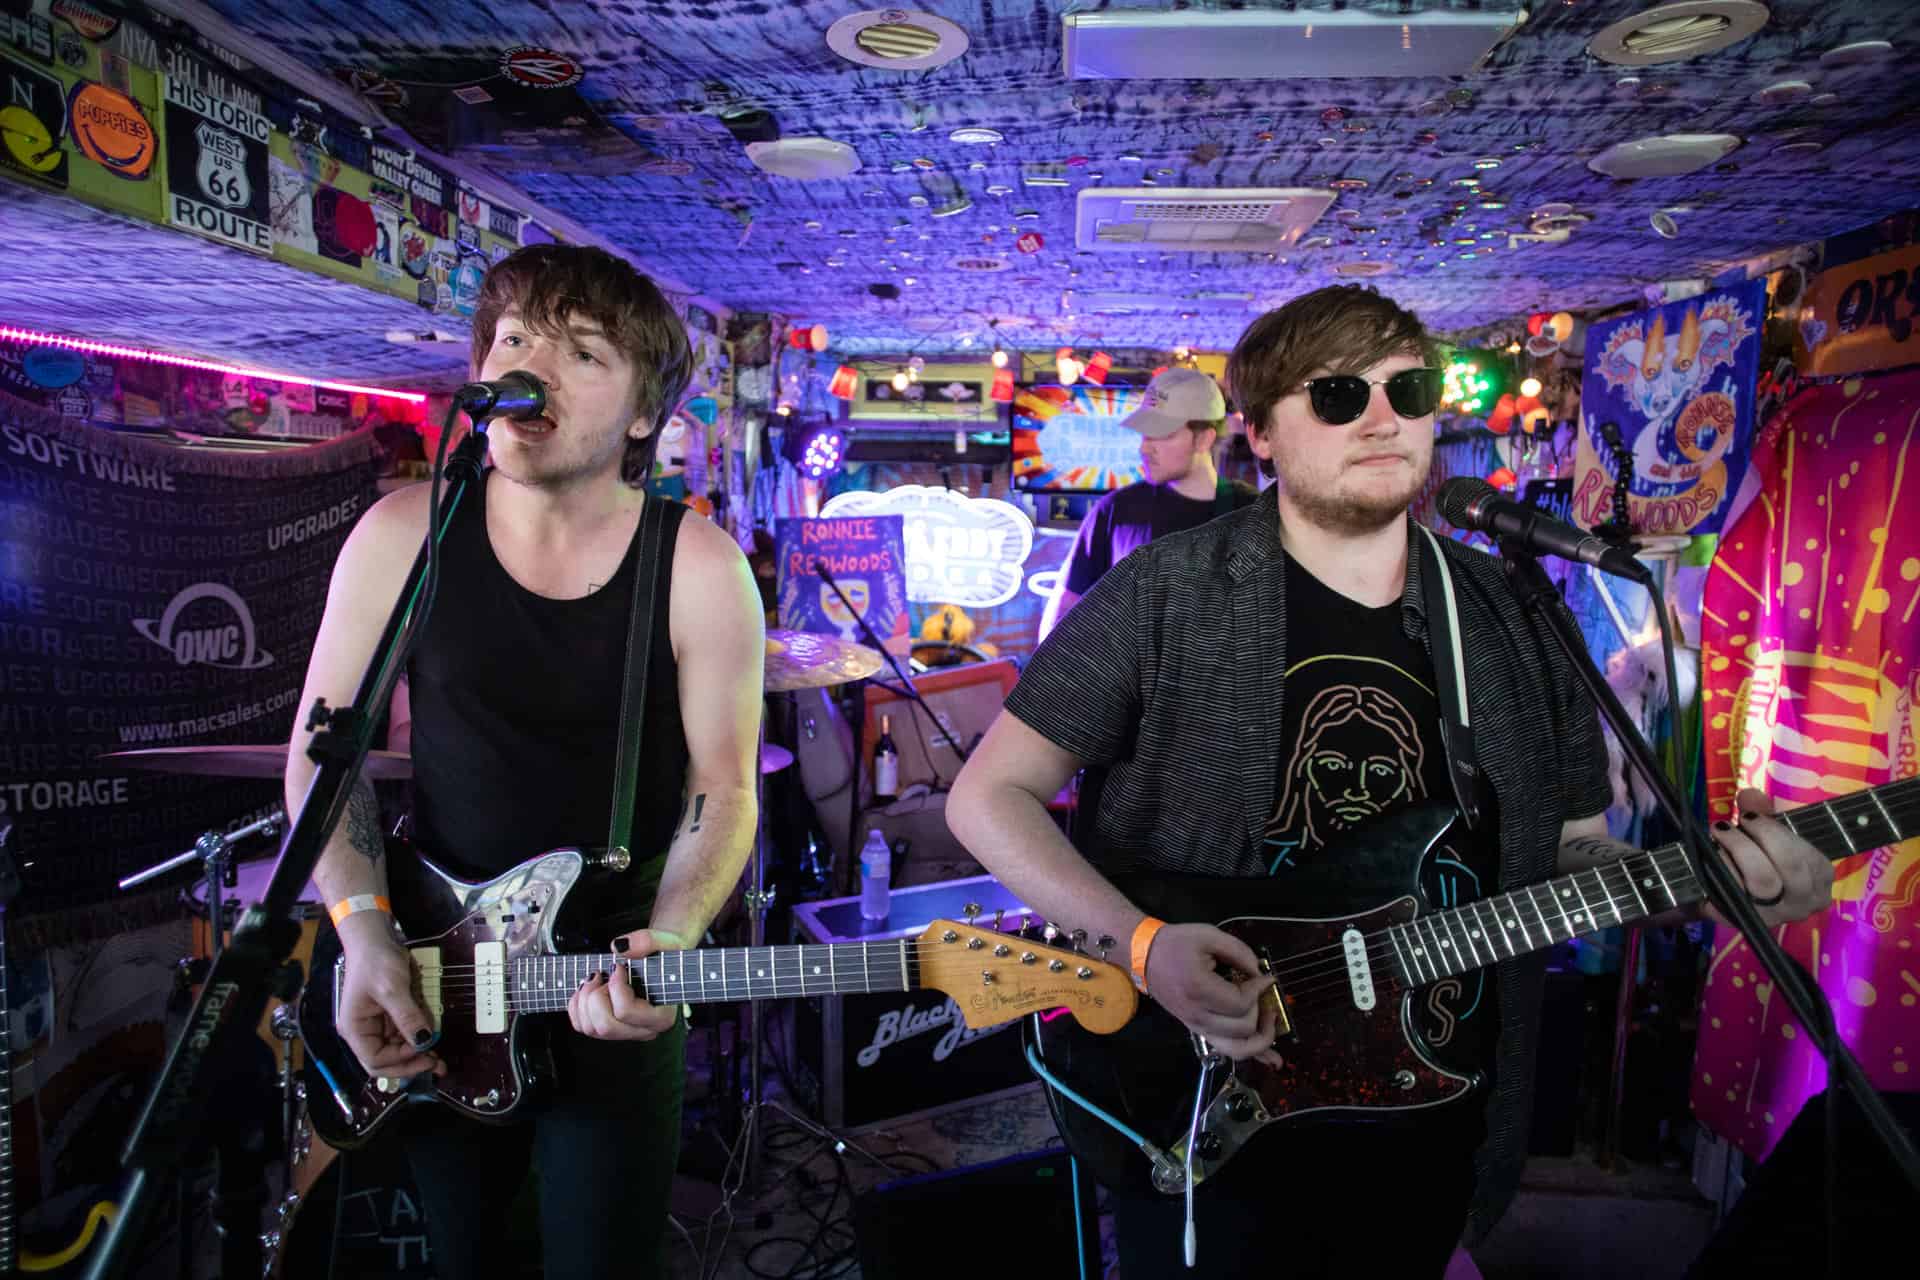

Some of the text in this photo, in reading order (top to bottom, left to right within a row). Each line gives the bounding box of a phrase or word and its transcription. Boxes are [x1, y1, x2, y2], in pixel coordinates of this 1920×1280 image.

[168, 76, 268, 140] HISTORIC
[201, 129, 242, 159] WEST
[209, 169, 241, 203] 66
[372, 159, 411, 191] VALLEY
[176, 197, 270, 250] ROUTE
[1, 425, 177, 494] SOFTWARE
[267, 495, 361, 552] UPGRADES
[1573, 468, 1718, 531] REWOODS
[802, 518, 878, 545] RONNIE
[175, 623, 239, 665] OWC
[118, 688, 299, 744] www.macsales.com
